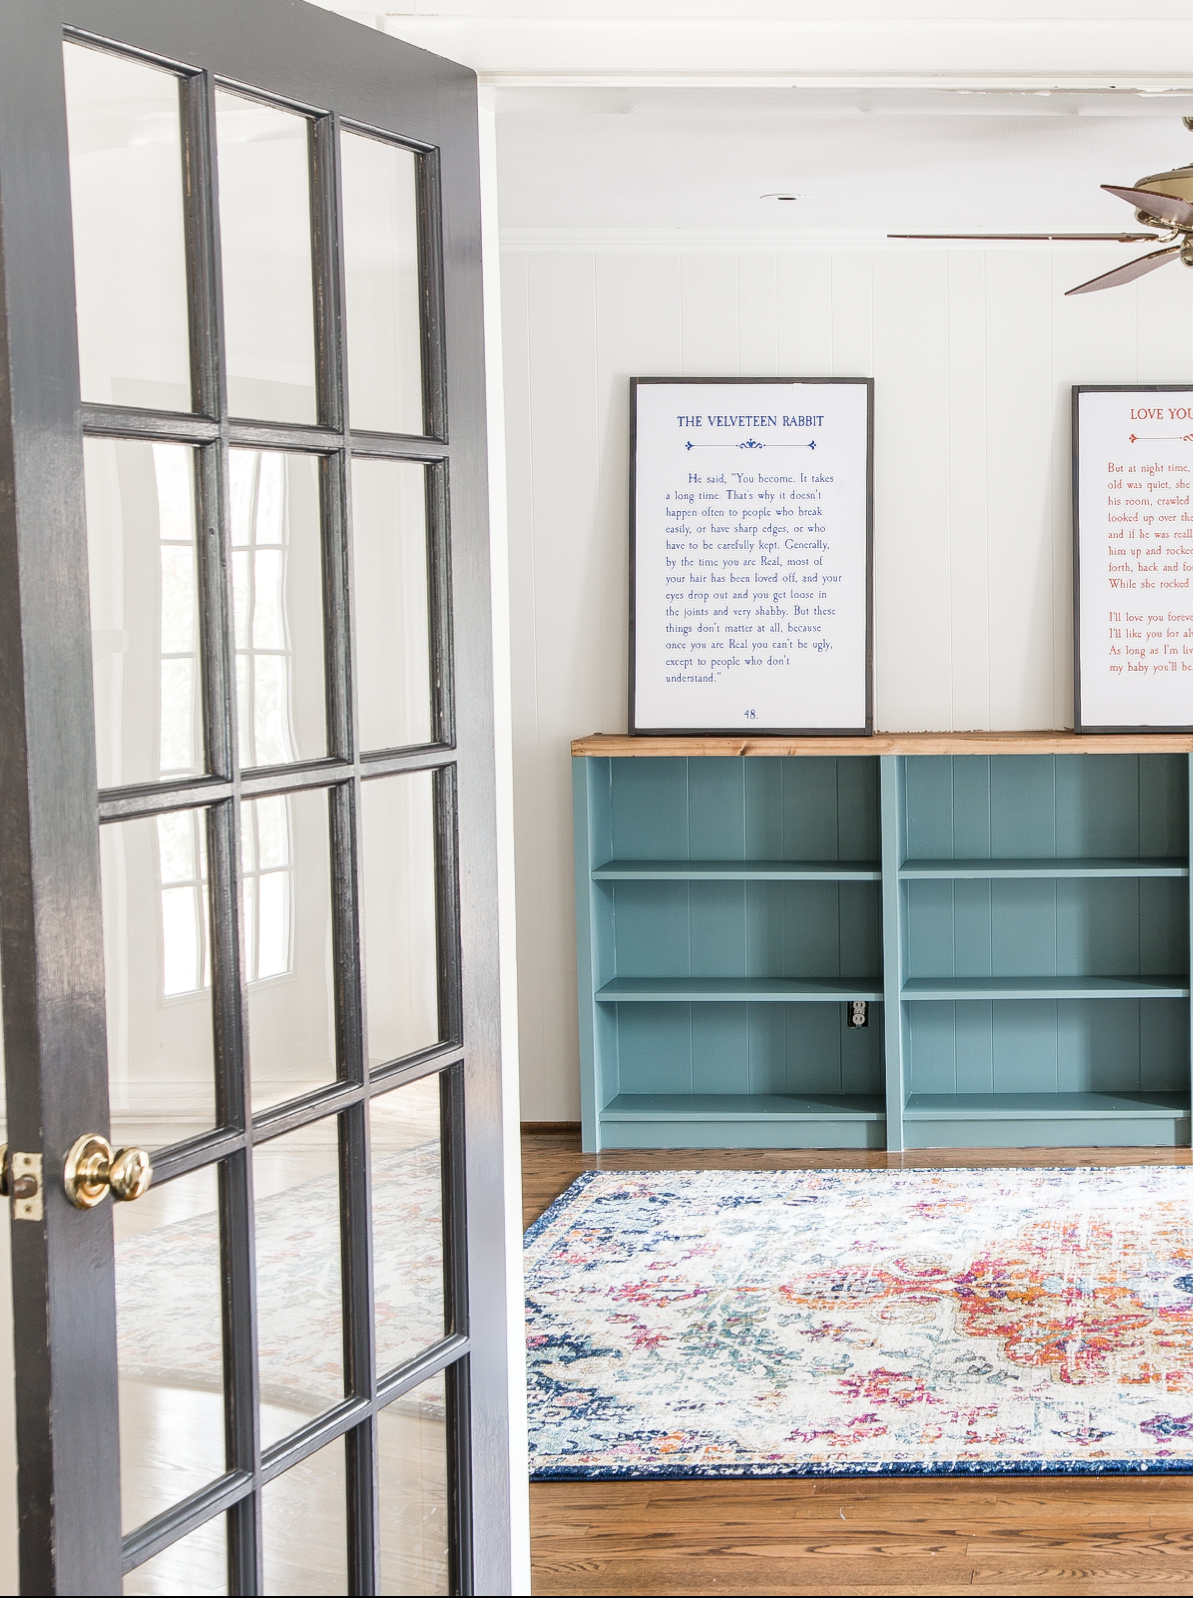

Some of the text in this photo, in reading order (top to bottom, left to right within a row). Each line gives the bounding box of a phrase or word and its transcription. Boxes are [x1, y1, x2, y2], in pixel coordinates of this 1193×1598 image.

[1130, 407, 1164, 420] LOVE
[676, 415, 825, 428] THE VELVETEEN RABBIT
[1107, 461, 1124, 473] But
[1127, 465, 1137, 473] at
[1140, 462, 1164, 477] night
[1167, 464, 1191, 473] time,
[687, 472, 834, 485] He said, "You become. It takes
[665, 488, 822, 505] a long time. That's why it doesn't
[1107, 495, 1122, 506] his
[1125, 498, 1153, 507] room,
[1156, 495, 1190, 506] crawled
[665, 505, 823, 521] happen often to people who break
[665, 539, 686, 550] have
[688, 542, 699, 550] to
[702, 539, 714, 550] be
[716, 538, 755, 554] carefully
[784, 538, 830, 553] Generally,
[1108, 545, 1127, 556] him
[1130, 548, 1142, 560] up
[1145, 544, 1162, 556] and
[665, 556, 677, 570] by
[680, 555, 695, 567] the
[698, 558, 719, 567] time
[721, 559, 740, 570] you
[742, 559, 757, 567] are
[786, 558, 809, 566] most
[813, 555, 824, 566] of
[1108, 577, 1137, 589] While
[1140, 577, 1156, 589] she
[1159, 577, 1190, 589] rocked
[1109, 611, 1122, 622] I'll
[1125, 611, 1144, 622] love
[1147, 615, 1164, 626] you
[665, 621, 822, 638] things don't matter at all, because
[1109, 627, 1122, 639] I'll
[1125, 628, 1143, 639] like
[1146, 631, 1163, 642] you
[1166, 627, 1180, 638] for
[1108, 644, 1122, 656] As
[1125, 645, 1147, 660] long
[1149, 647, 1160, 655] as
[1163, 644, 1179, 655] I'm
[1109, 665, 1124, 676] my
[1127, 661, 1150, 676] baby
[665, 671, 722, 683] understand."
[743, 708, 759, 720] 48.
